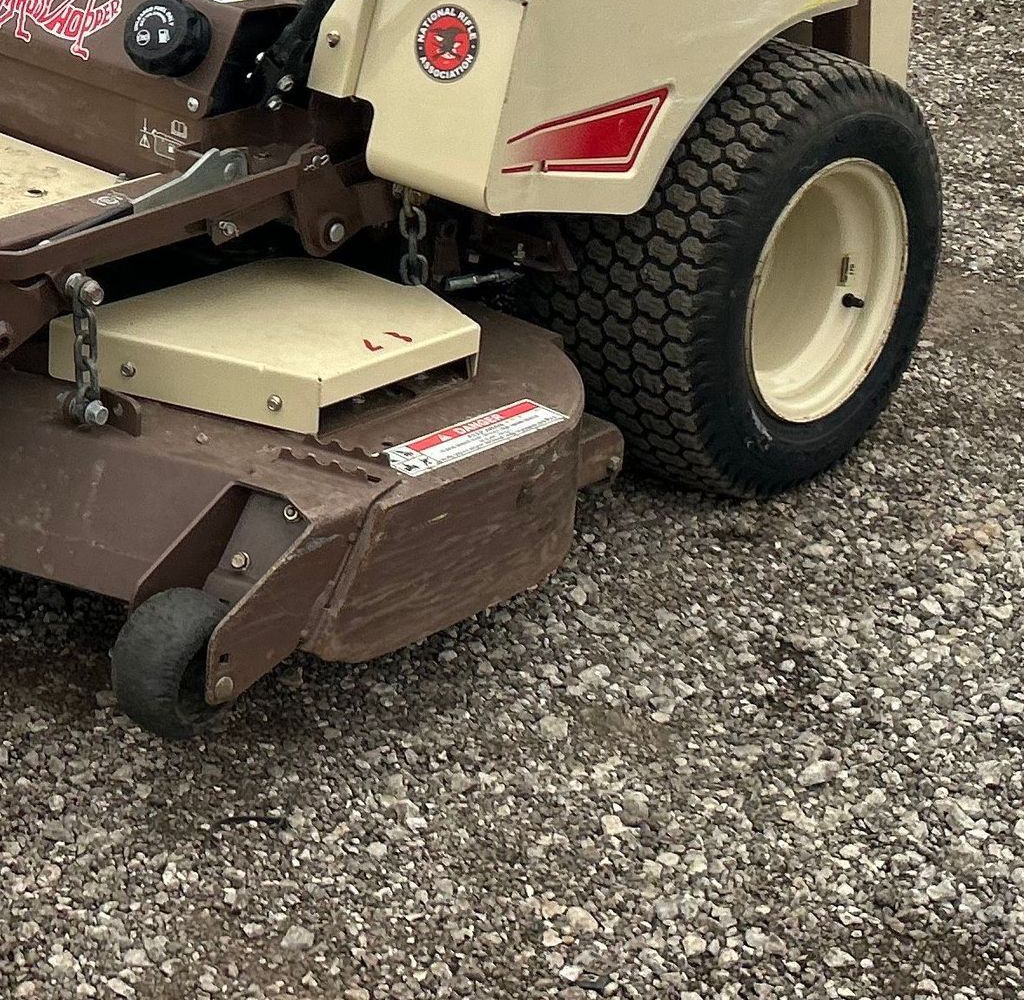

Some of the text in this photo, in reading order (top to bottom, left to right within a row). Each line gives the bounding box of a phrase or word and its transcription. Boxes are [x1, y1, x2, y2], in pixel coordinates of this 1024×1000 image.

[417, 7, 477, 43] NATIONAL RIFLE
[419, 53, 474, 79] ASSOCIATION
[452, 413, 503, 436] DANGER
